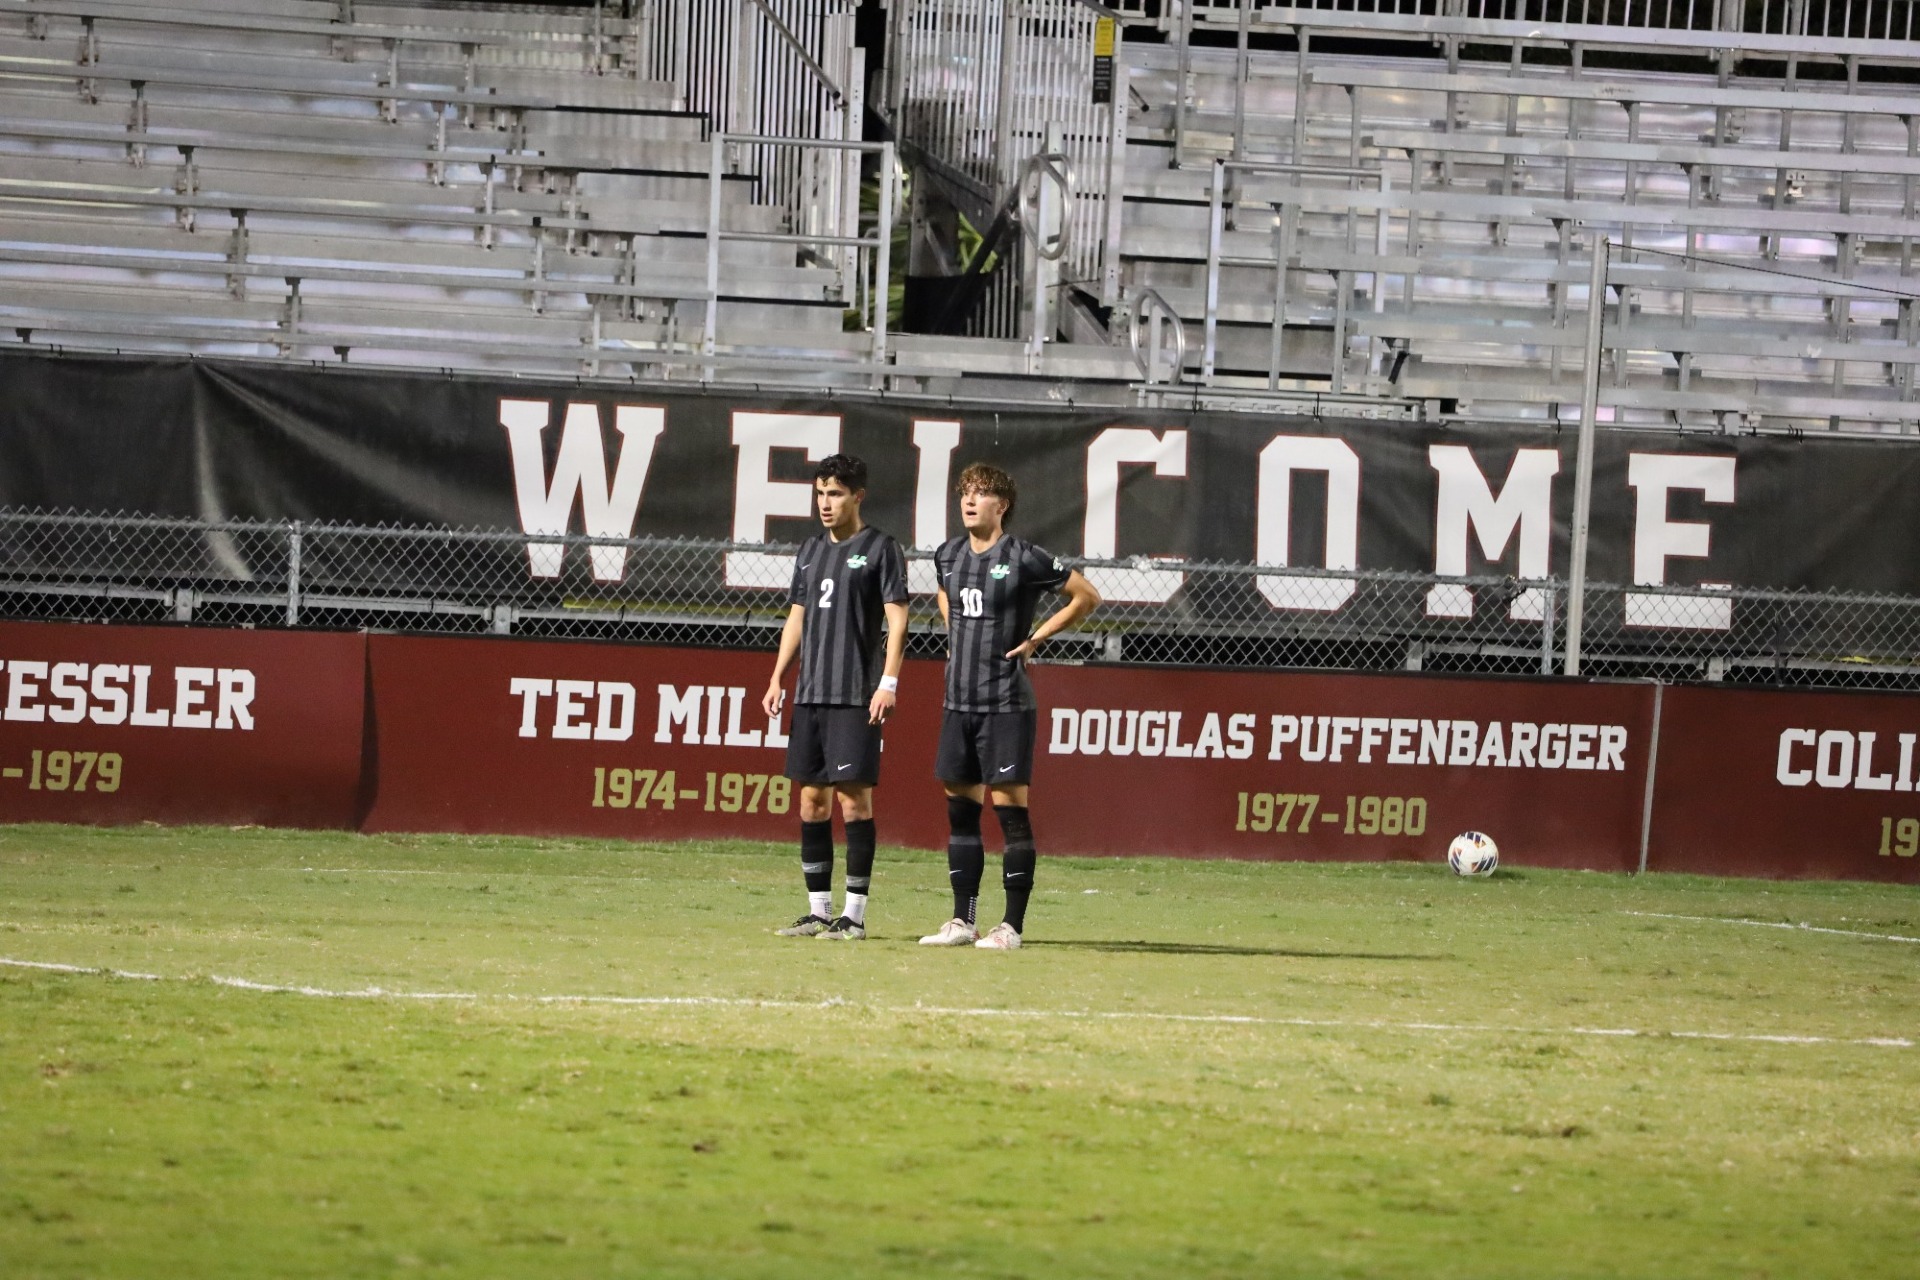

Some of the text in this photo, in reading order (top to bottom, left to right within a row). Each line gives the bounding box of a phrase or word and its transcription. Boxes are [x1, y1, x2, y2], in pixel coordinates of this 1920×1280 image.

[818, 578, 835, 609] 2
[959, 587, 983, 618] 10
[0, 659, 256, 731] ESSLER
[509, 677, 884, 754] TED MILL
[1048, 707, 1628, 771] DOUGLAS PUFFENBARGER
[1776, 728, 1920, 792] COLI
[592, 767, 792, 815] 1974-1978
[1235, 792, 1428, 836] 1977-1980
